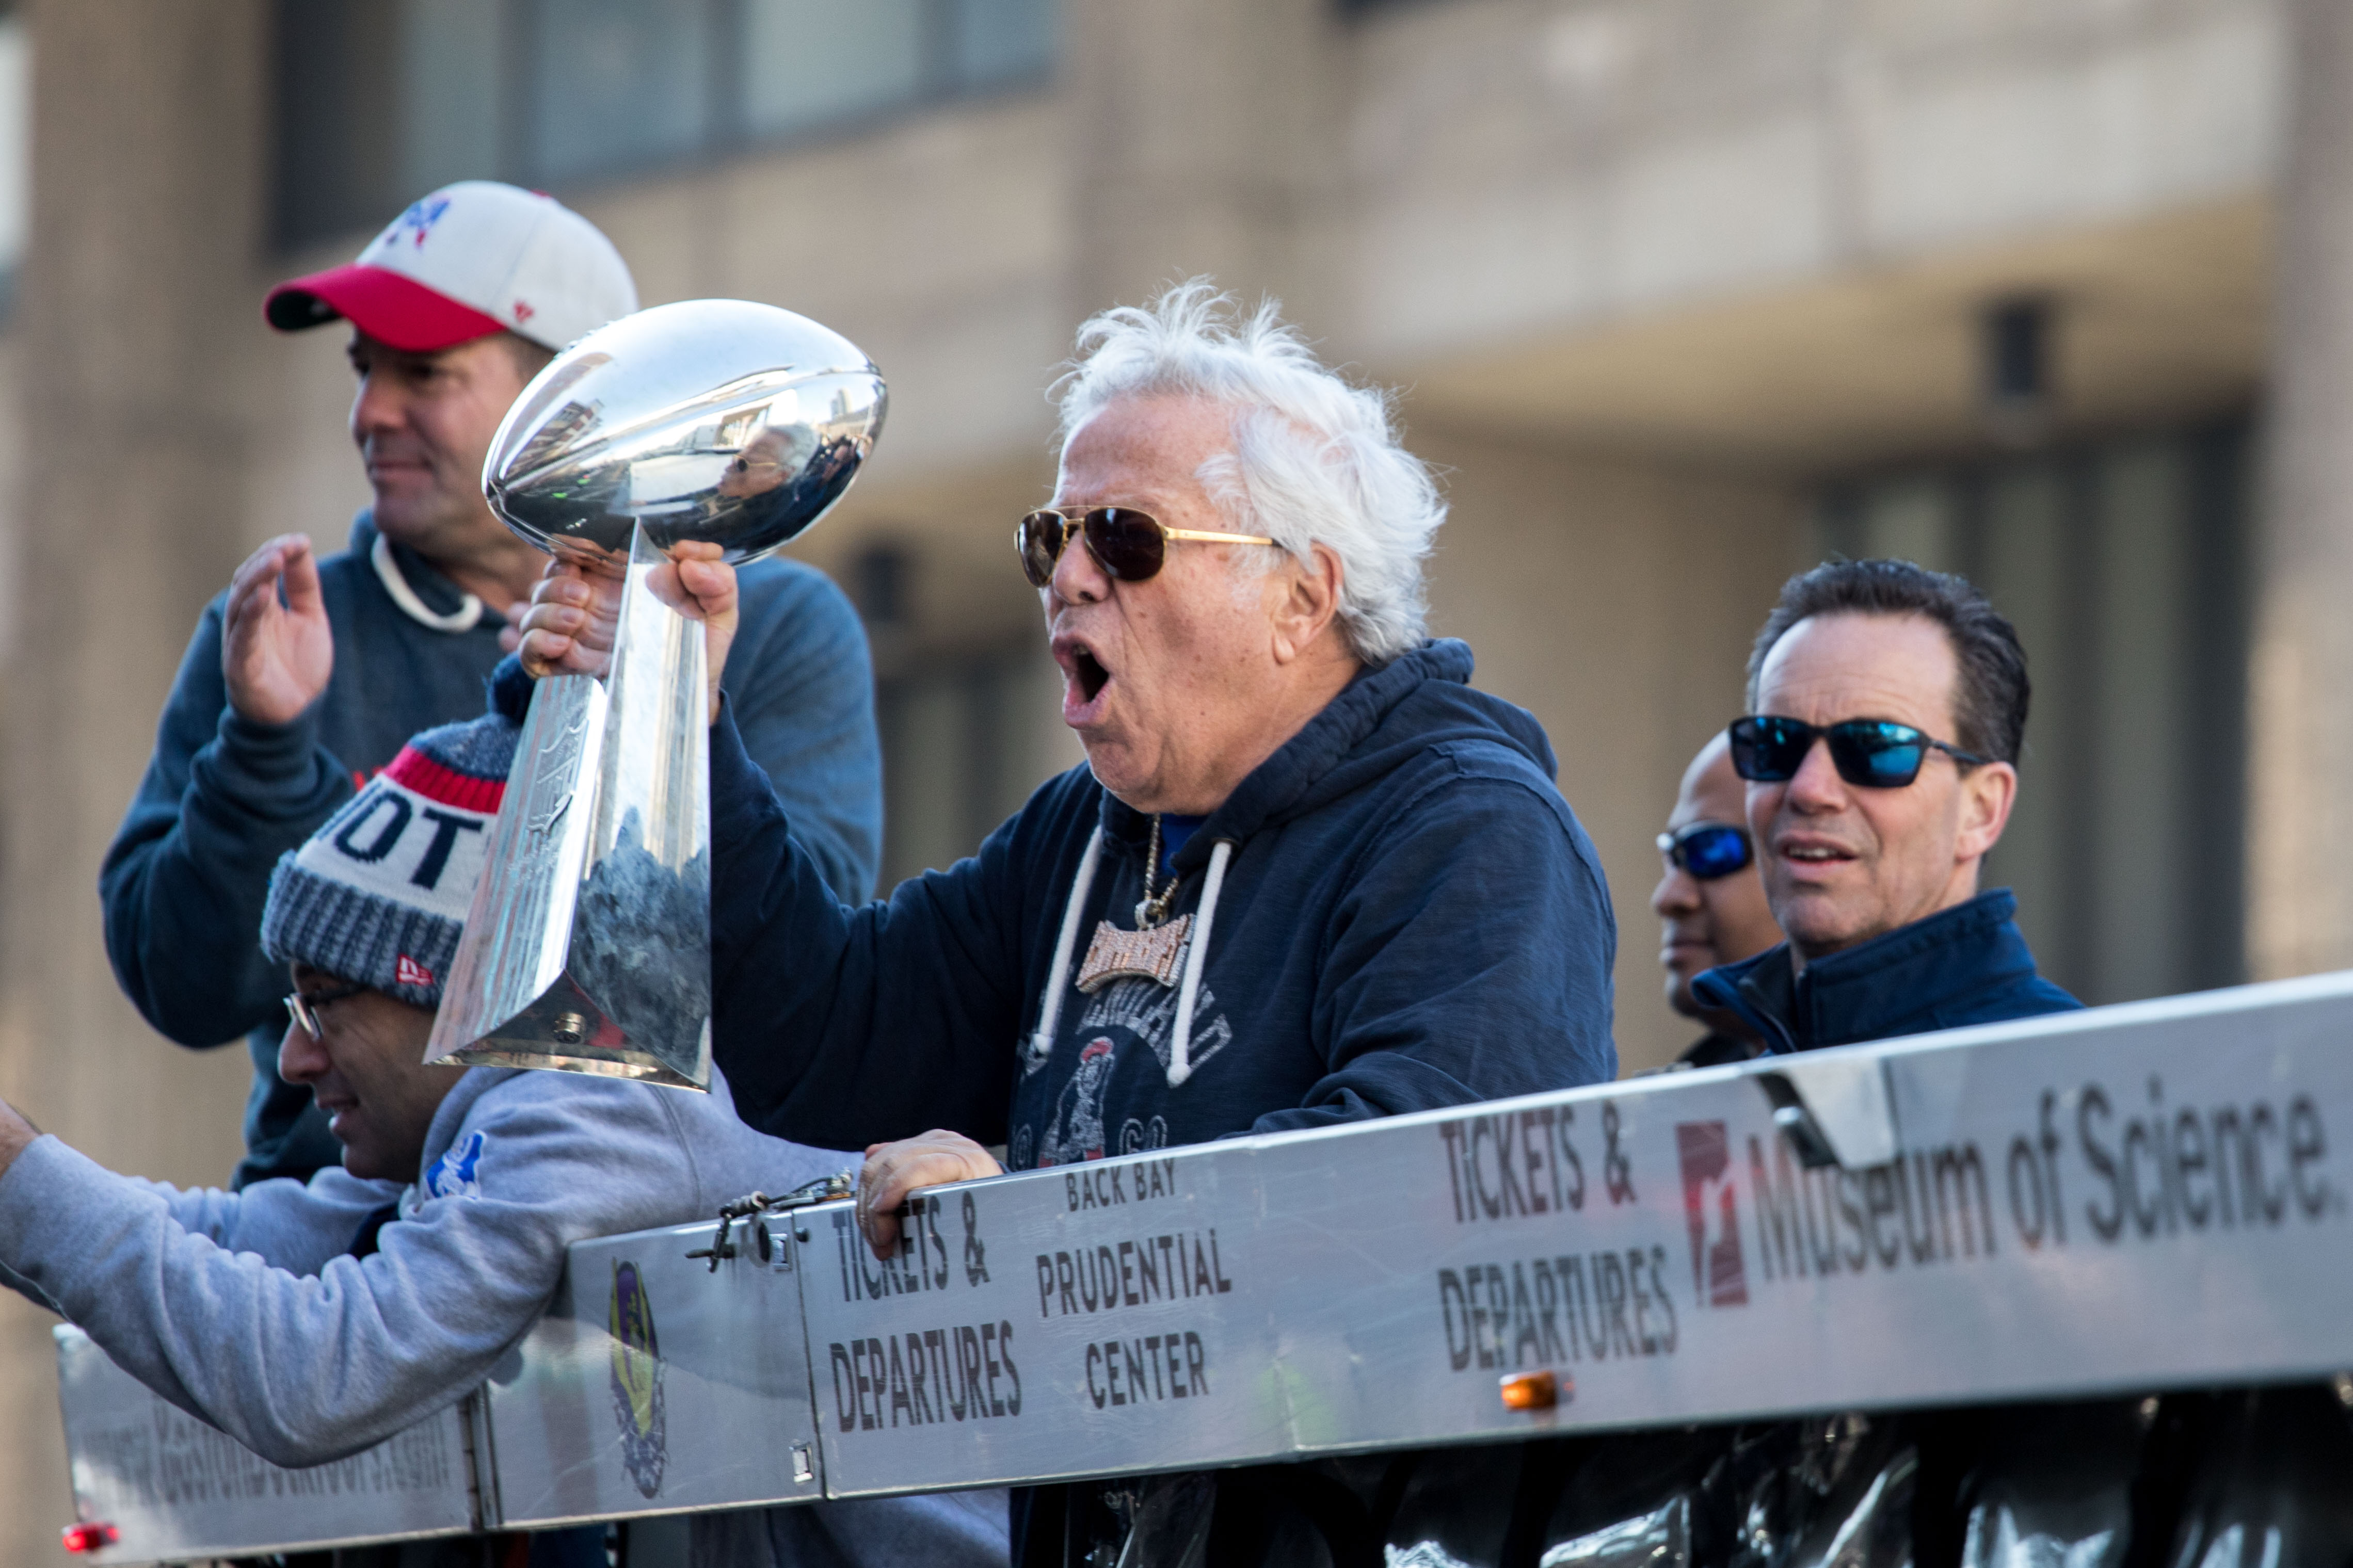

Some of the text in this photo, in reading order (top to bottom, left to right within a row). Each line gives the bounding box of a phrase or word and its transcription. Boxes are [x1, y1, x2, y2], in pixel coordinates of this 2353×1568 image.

[1065, 1157, 1175, 1213] BACK BAY
[1438, 1097, 1637, 1224] TICKETS &
[1747, 1130, 1999, 1284] Museum
[2006, 1085, 2066, 1251] of
[962, 1190, 991, 1288] &
[1035, 1227, 1232, 1318] PRUDENTIAL
[1437, 1243, 1680, 1373] DEPARTURES
[829, 1319, 1022, 1433] DEPARTURES
[1085, 1330, 1211, 1411] CENTER
